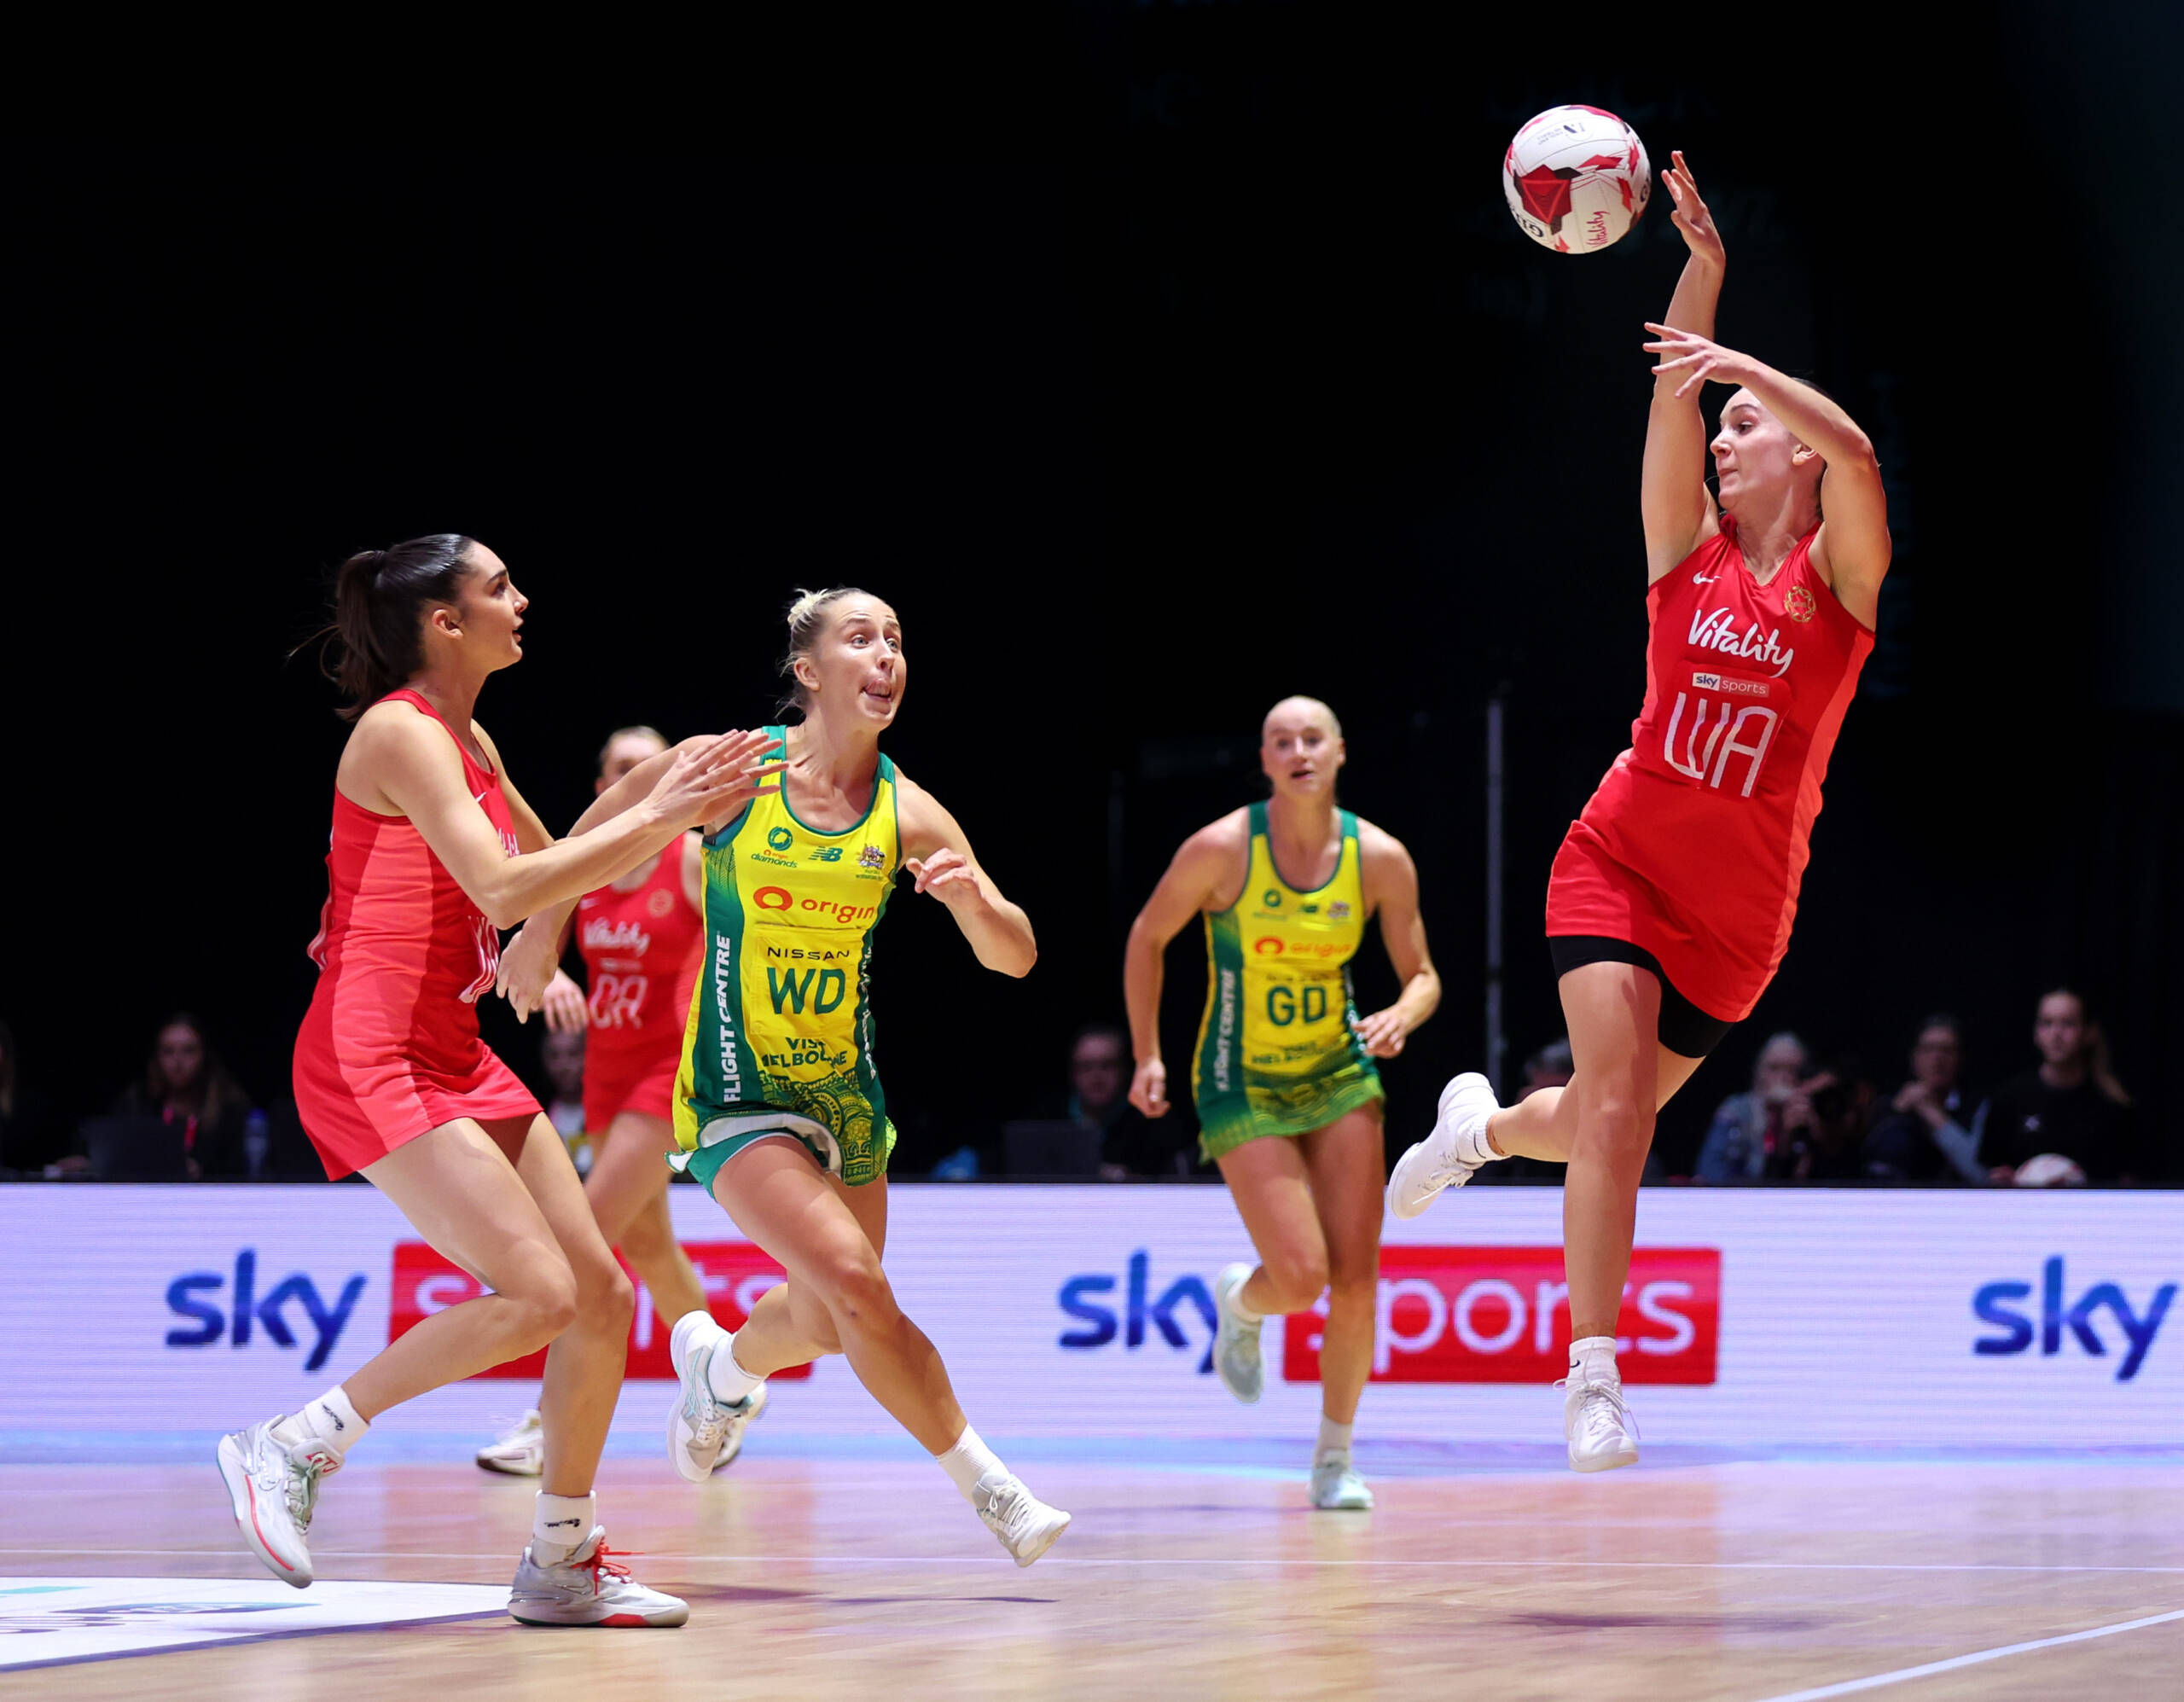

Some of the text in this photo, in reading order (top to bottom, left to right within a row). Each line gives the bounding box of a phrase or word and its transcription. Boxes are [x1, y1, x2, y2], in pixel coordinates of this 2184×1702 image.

[1687, 607, 1794, 677] Vitality
[1696, 674, 1767, 694] sky sports
[1664, 692, 1778, 798] WA
[751, 853, 798, 868] diamonds
[801, 899, 874, 924] origin
[768, 946, 850, 961] NISSAN
[766, 967, 846, 1015] WD
[1267, 985, 1326, 1026] GD
[715, 934, 741, 1103] FLIGHT CENTRE
[166, 1248, 368, 1371] sky
[1973, 1255, 2177, 1380] sky
